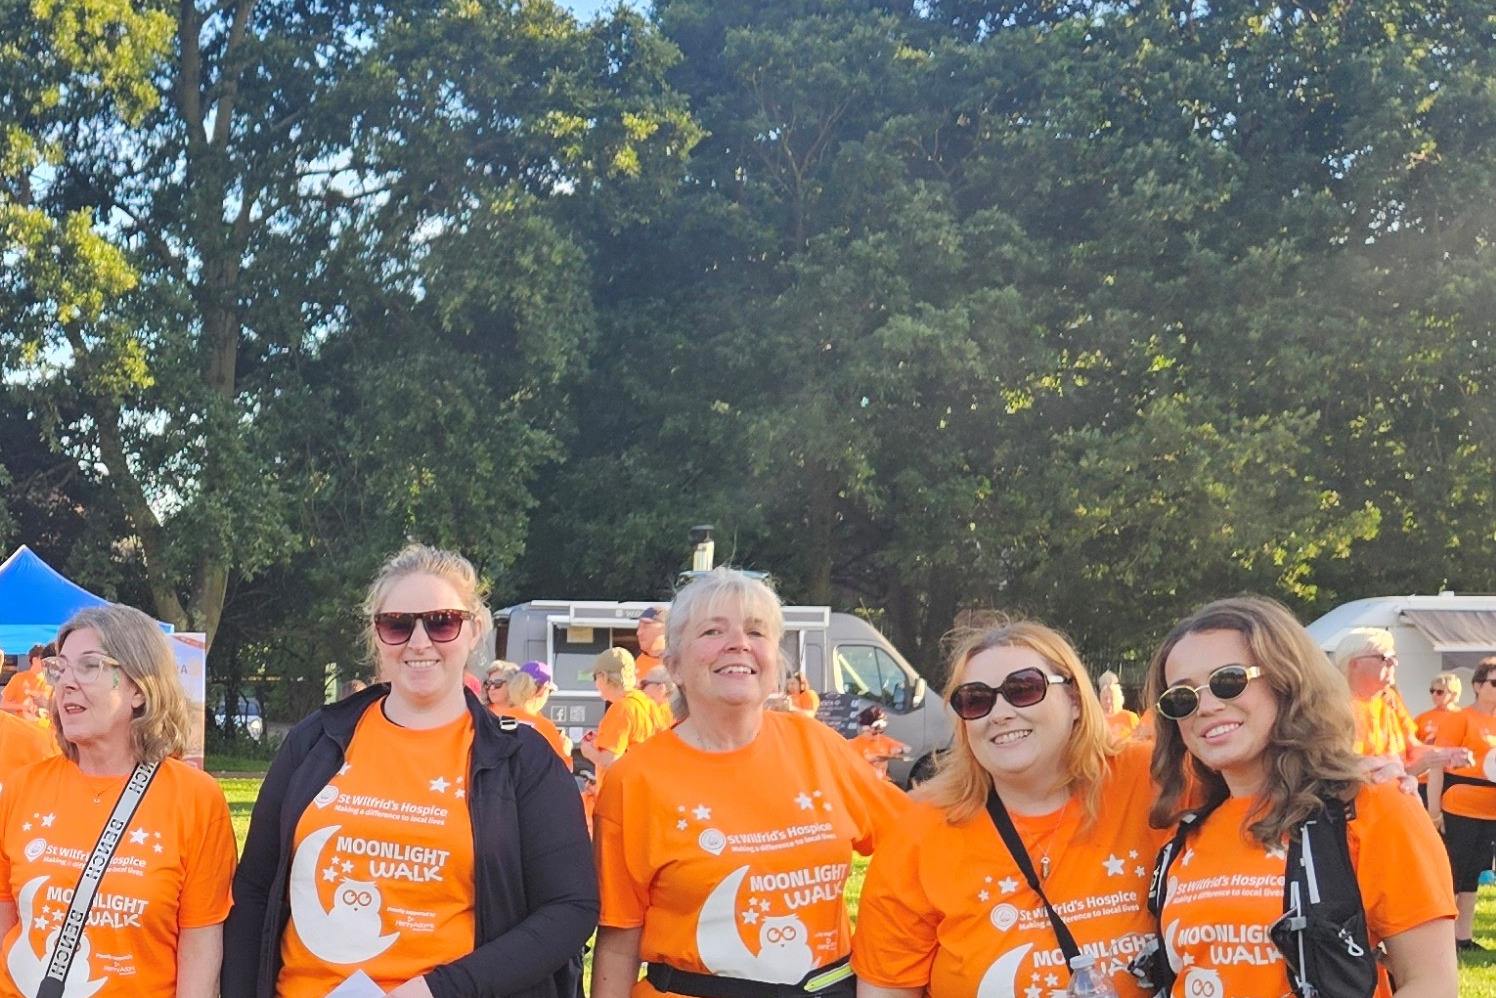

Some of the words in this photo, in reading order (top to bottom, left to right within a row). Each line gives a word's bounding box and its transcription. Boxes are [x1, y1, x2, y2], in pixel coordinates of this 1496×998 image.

[334, 804, 360, 815] Making
[365, 808, 401, 821] difference
[409, 815, 428, 823] local
[337, 793, 351, 804] St
[352, 795, 400, 811] Wilfrid's
[400, 802, 449, 818] Hospice
[726, 834, 740, 845] St
[739, 829, 787, 844] Wilfrid's
[786, 822, 833, 838] Hospice
[45, 845, 60, 856] St
[85, 818, 124, 880] BENCH
[336, 836, 451, 867] MOONLIGHT
[370, 860, 443, 882] WALK
[749, 864, 849, 892] MOONLIGHT
[1176, 884, 1187, 895] St
[1186, 875, 1230, 893] Wilfrid's
[1230, 873, 1286, 888] Hospice
[783, 880, 843, 910] WALK
[1019, 909, 1032, 922] St
[1086, 890, 1138, 911] Hospice
[1172, 894, 1192, 905] aking
[1241, 888, 1262, 896] local
[1018, 920, 1046, 931] Making
[1092, 909, 1102, 918] to
[1102, 906, 1124, 917] local
[1122, 904, 1140, 913] lives
[51, 909, 84, 977] BENCH
